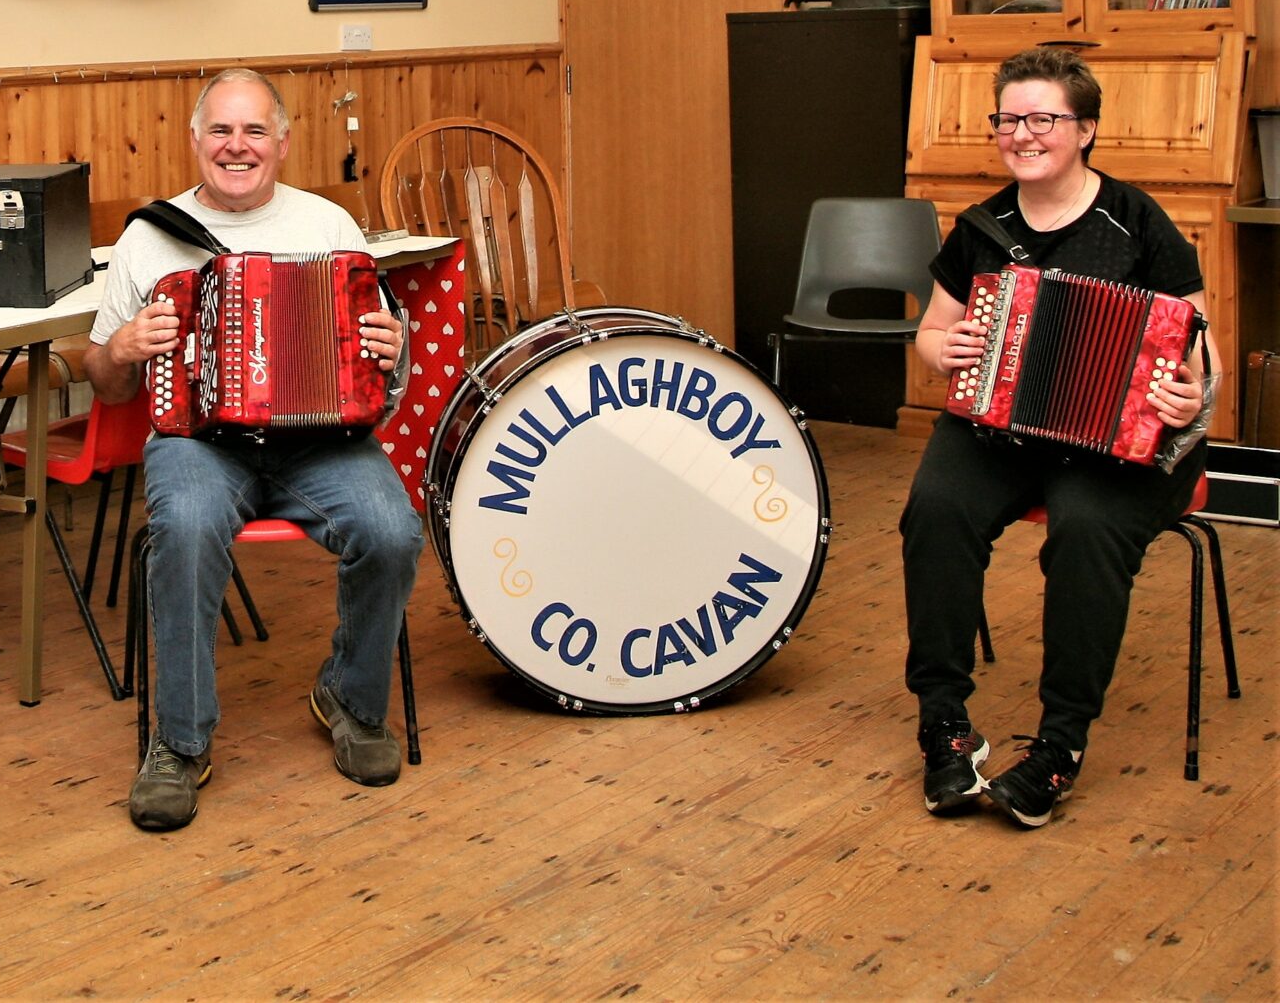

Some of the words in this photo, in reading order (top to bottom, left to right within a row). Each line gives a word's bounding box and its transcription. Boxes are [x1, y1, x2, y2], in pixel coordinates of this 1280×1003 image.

[1000, 313, 1028, 382] Lisheen
[478, 357, 783, 515] MULLAGHBOY
[530, 601, 598, 673] CO.
[619, 552, 783, 678] CAVAN
